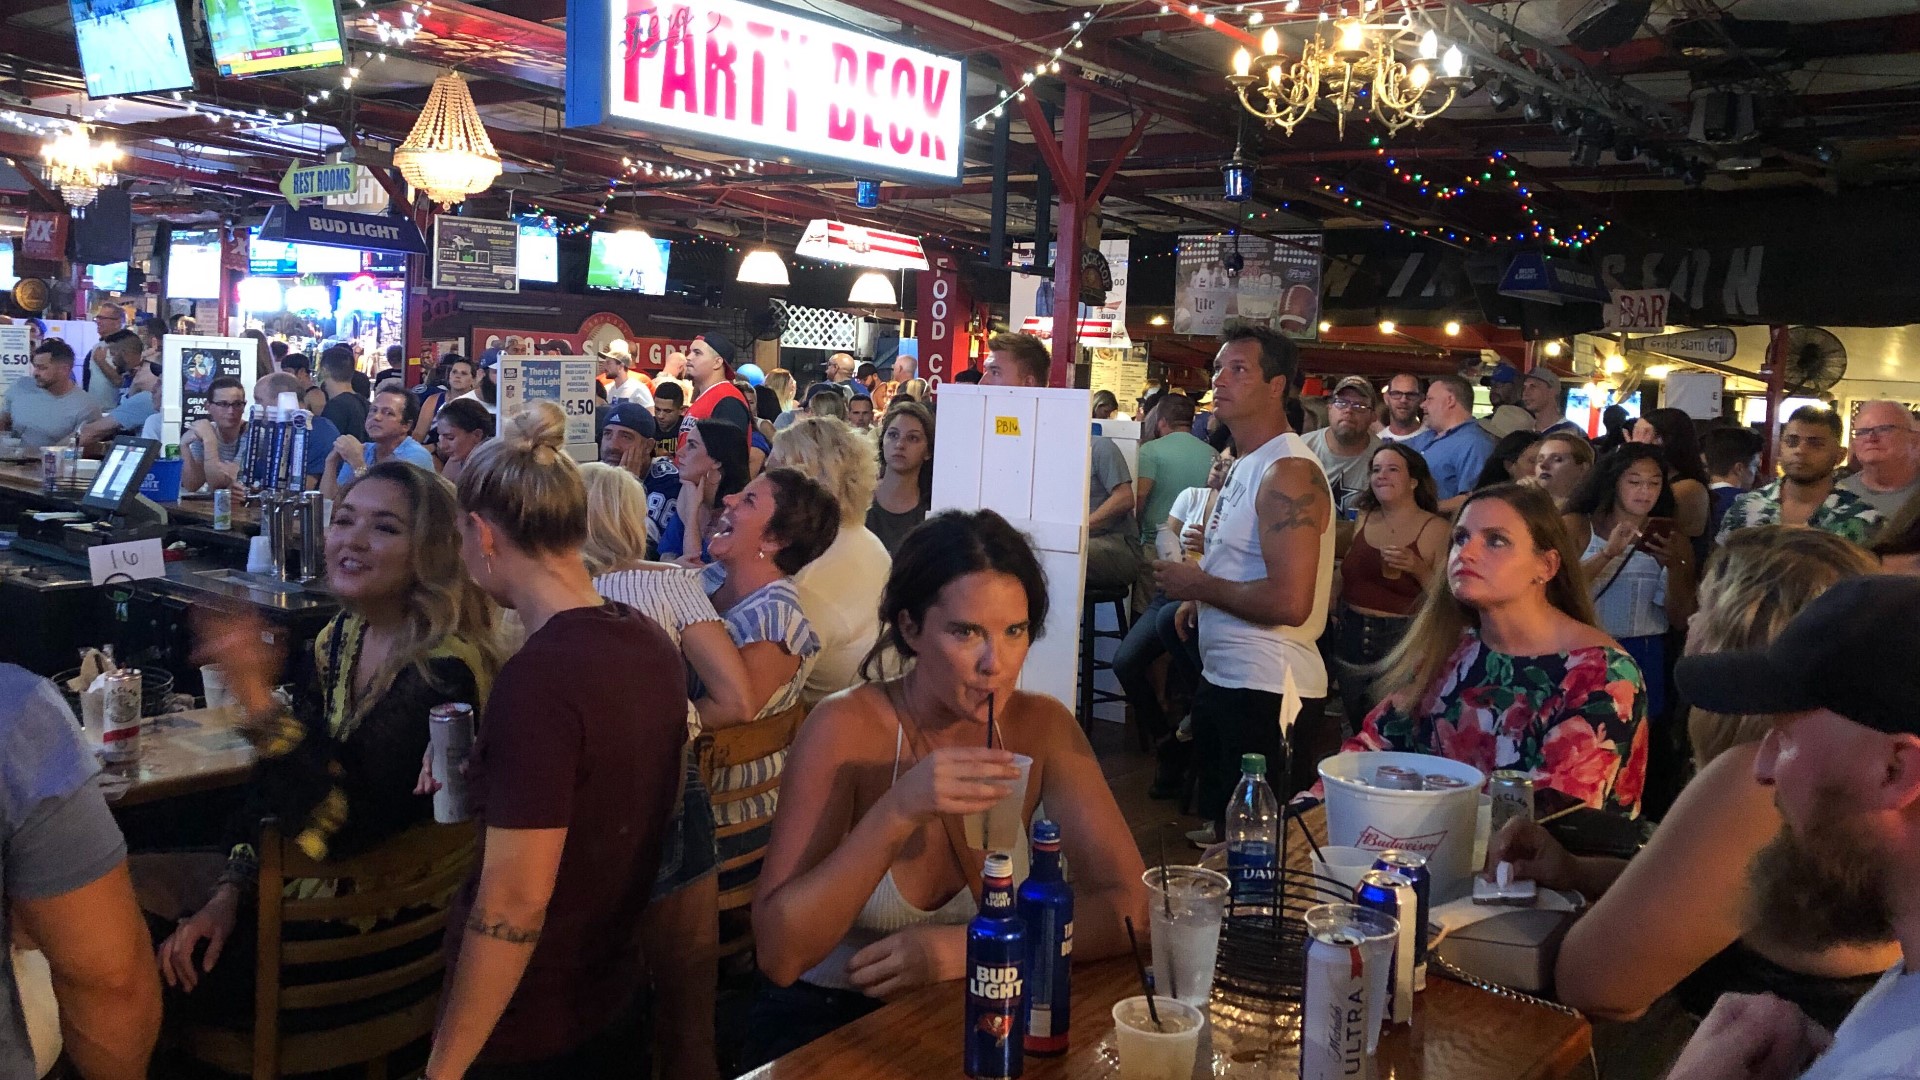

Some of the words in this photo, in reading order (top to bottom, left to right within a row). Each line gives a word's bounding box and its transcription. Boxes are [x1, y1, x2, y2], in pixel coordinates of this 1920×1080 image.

[622, 0, 808, 133] PARTY
[828, 42, 950, 161] DECK
[293, 170, 315, 195] REST
[317, 167, 350, 192] ROOMS
[308, 216, 348, 234] BUD
[350, 221, 400, 240] LIGHT
[931, 257, 949, 341] FOOD
[1194, 296, 1216, 313] Lite
[1620, 294, 1666, 328] BAR
[1650, 340, 1678, 350] Grand
[1680, 338, 1705, 352] Slam
[1707, 334, 1728, 355] Grill
[220, 357, 240, 365] 16oz
[223, 367, 240, 375] Tall
[528, 367, 553, 376] There's
[528, 377, 543, 386] Bud
[543, 377, 560, 388] Light
[528, 388, 549, 396] there.
[110, 549, 139, 570] 16
[1361, 832, 1440, 851] Budweiser
[985, 898, 1012, 908] LIGHT
[988, 890, 1008, 901] BUD
[976, 965, 1018, 984] BUD
[970, 978, 1023, 1000] LIGHT
[1328, 1002, 1342, 1064] Michelob
[1344, 987, 1364, 1075] ULTRA
